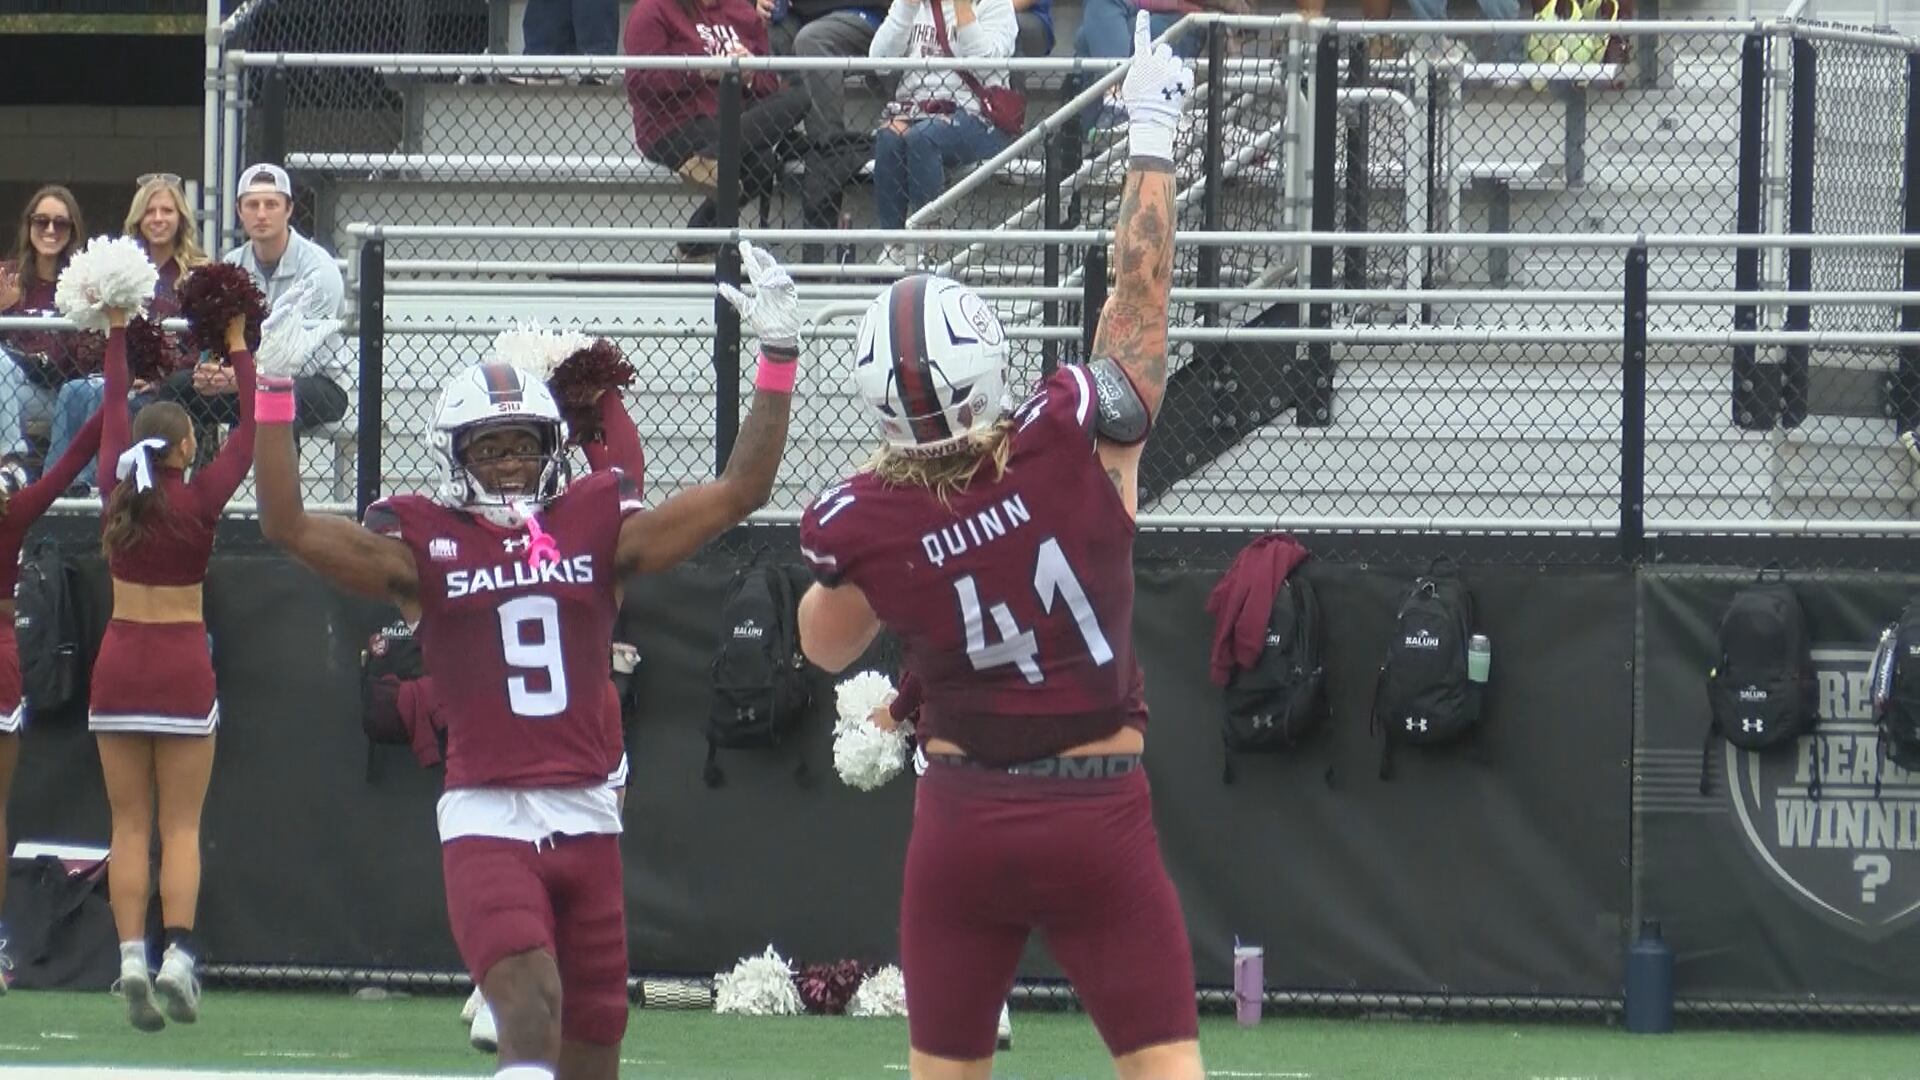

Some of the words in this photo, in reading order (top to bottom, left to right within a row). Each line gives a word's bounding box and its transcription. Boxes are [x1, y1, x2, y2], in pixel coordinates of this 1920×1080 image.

[921, 493, 1031, 567] QUINN
[446, 554, 594, 599] SALUKIS
[953, 536, 1115, 685] 41
[497, 595, 568, 717] 9
[1817, 670, 1875, 719] RE
[1795, 734, 1920, 785] REA
[1775, 799, 1920, 850] WINNI
[1853, 854, 1892, 903] ?
